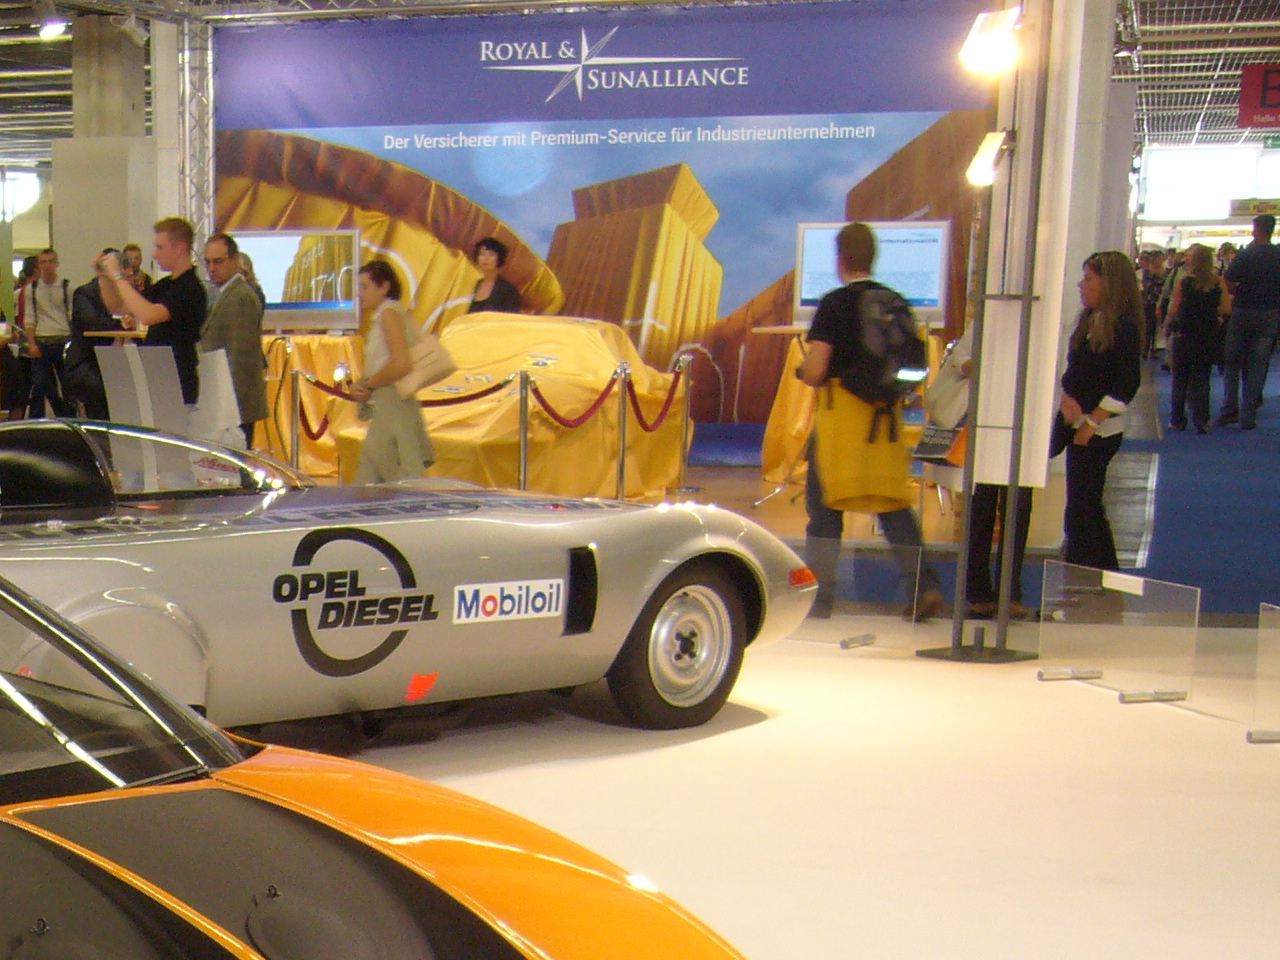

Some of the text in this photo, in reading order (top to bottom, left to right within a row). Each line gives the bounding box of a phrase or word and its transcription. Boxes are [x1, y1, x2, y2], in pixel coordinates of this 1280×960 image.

[480, 40, 578, 61] ROYAL &
[587, 67, 749, 90] SUNALLIANCE
[383, 122, 876, 150] Der Versicherer mit Premium-Service für Industrieunternehmen
[272, 569, 367, 604] OPEL
[456, 583, 562, 620] Mobiloil
[317, 593, 440, 631] DIESEL
